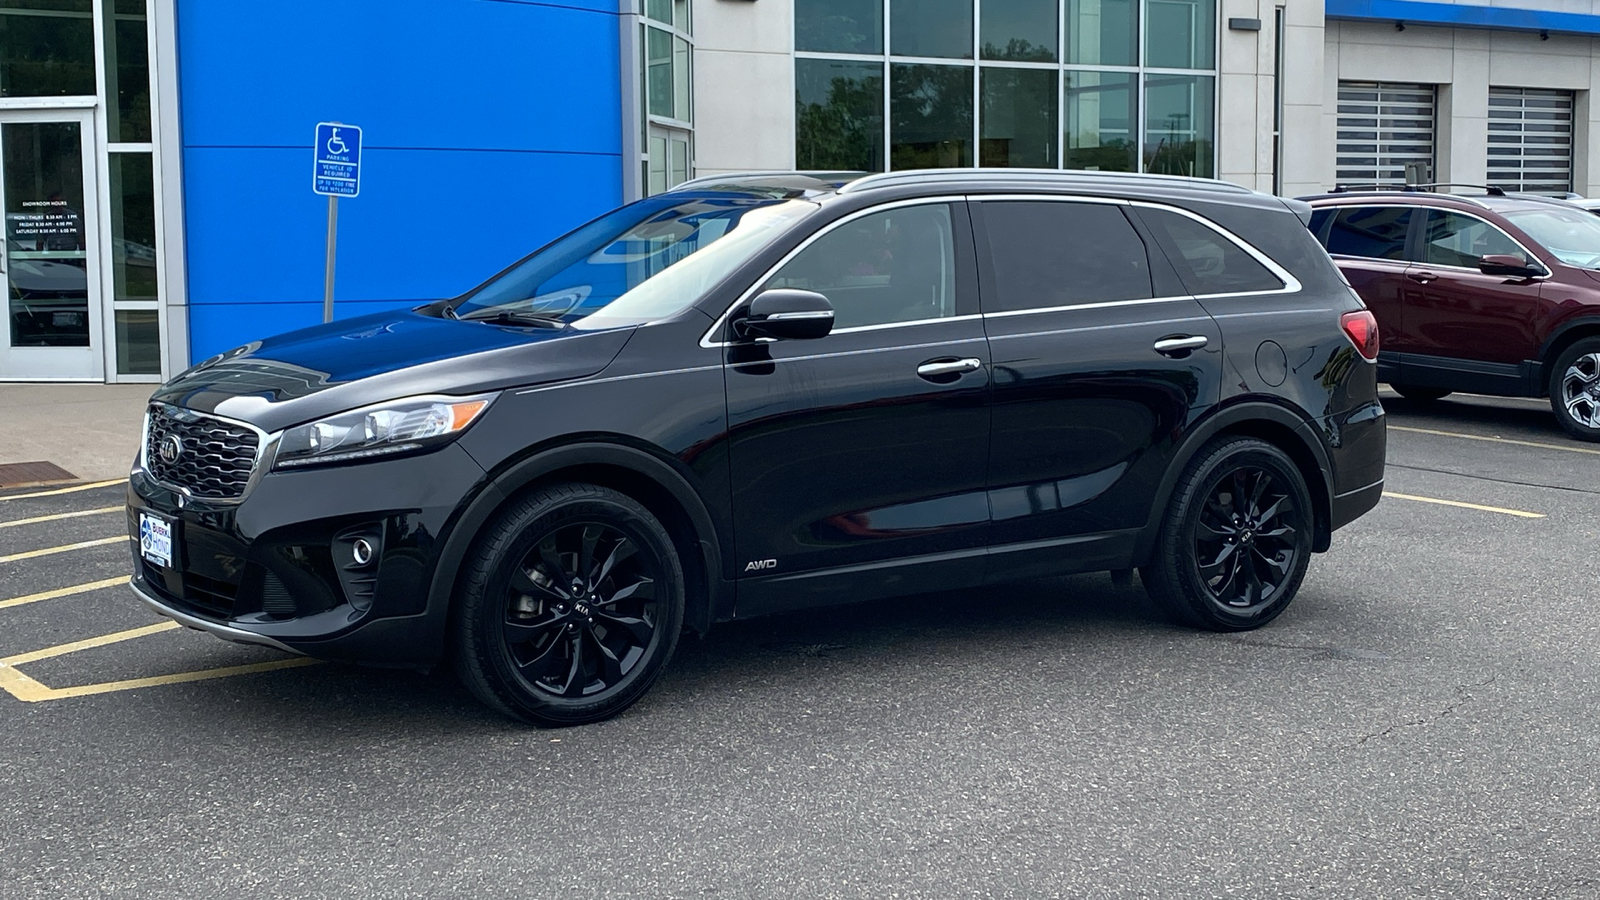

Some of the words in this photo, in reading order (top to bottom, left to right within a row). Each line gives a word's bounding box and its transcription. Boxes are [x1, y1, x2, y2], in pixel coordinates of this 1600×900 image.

[326, 154, 350, 162] PARKING
[323, 170, 351, 178] REQUIRED
[161, 441, 175, 459] KIA
[1241, 531, 1252, 543] KIA
[152, 532, 171, 556] HOND
[744, 558, 777, 572] AWD
[574, 603, 589, 616] KIA
